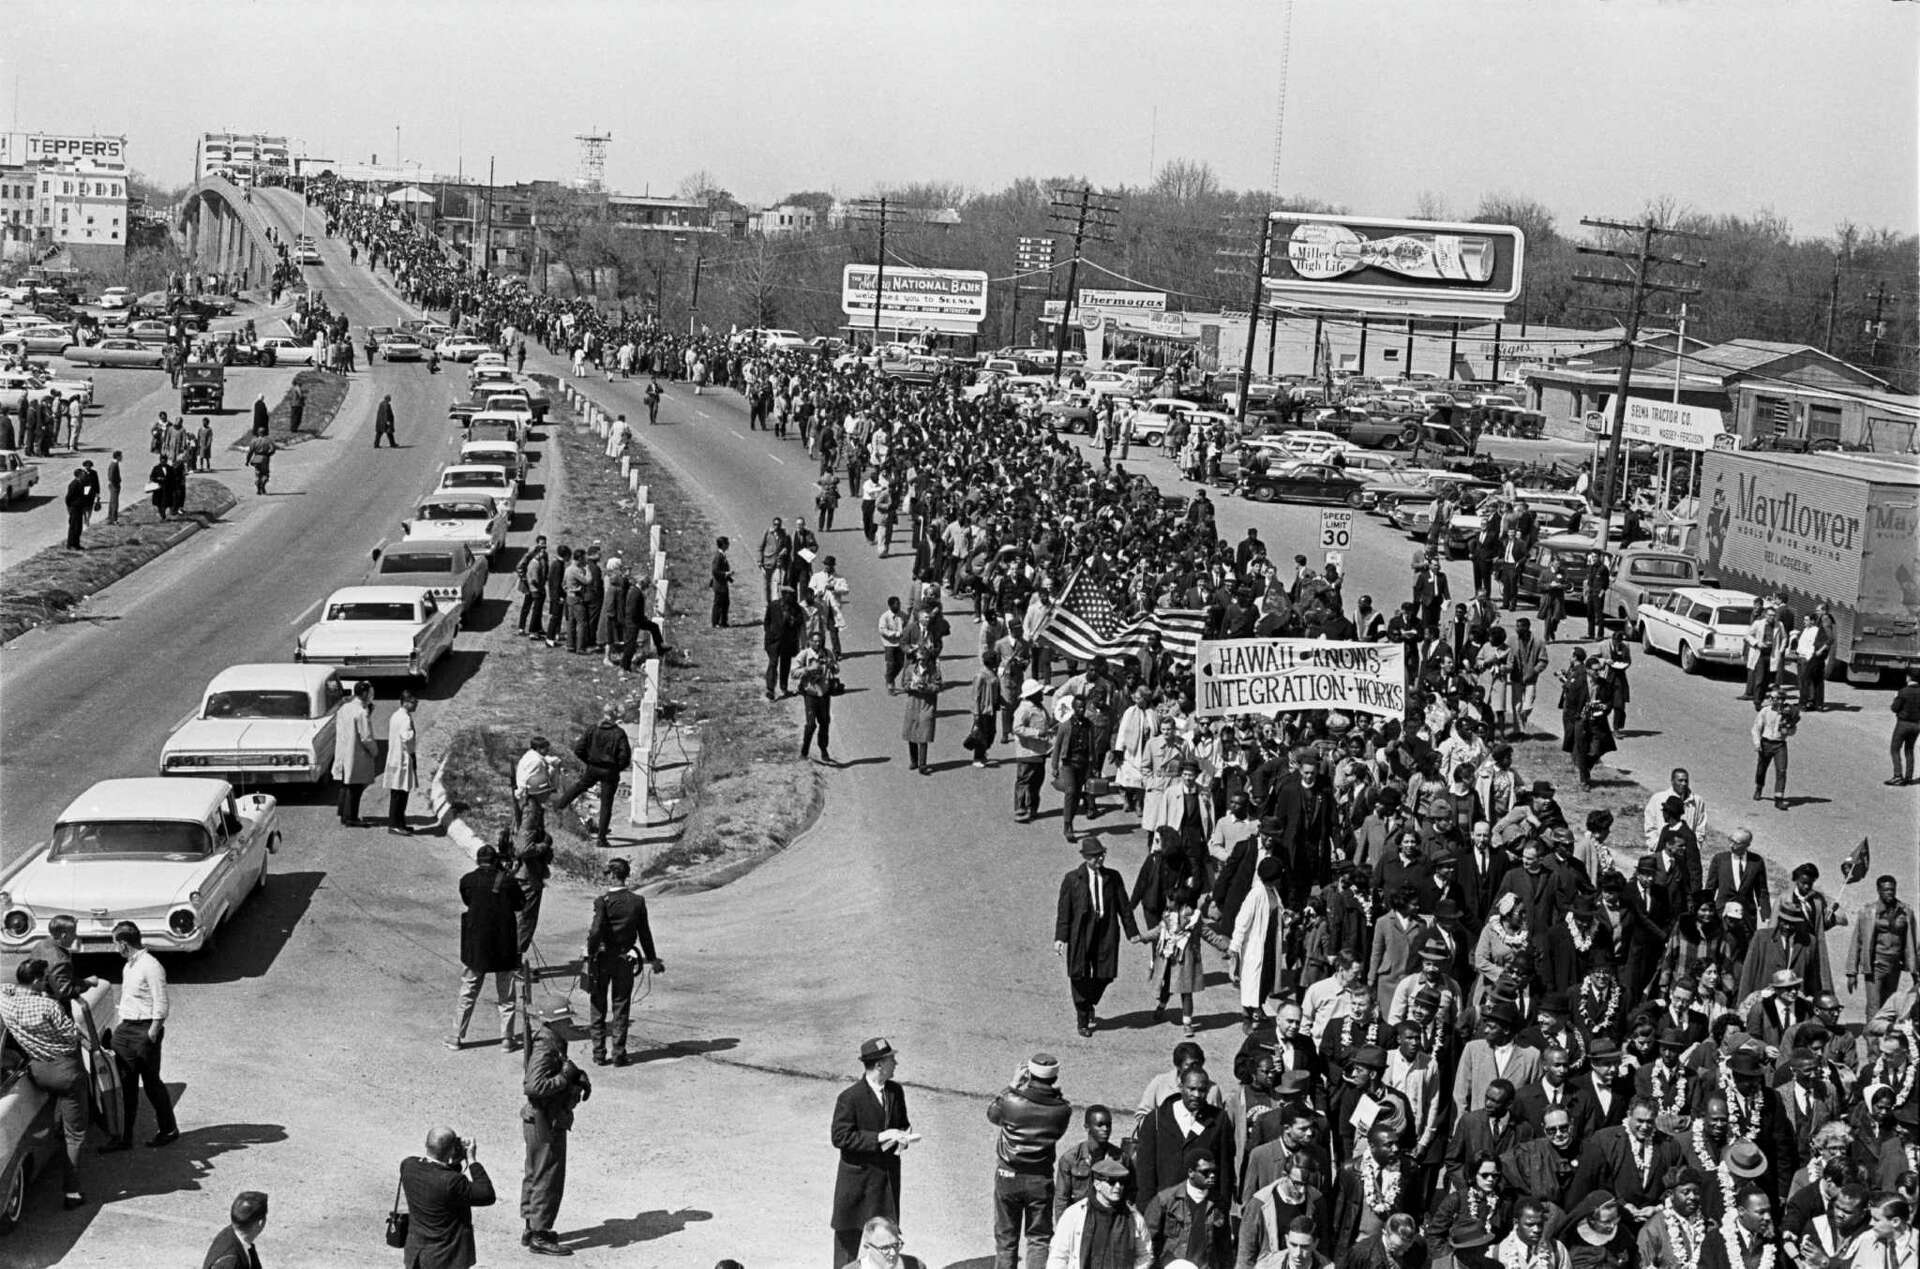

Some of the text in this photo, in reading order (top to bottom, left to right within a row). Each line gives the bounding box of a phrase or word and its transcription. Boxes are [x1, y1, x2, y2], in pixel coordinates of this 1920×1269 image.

[1293, 246, 1329, 259] Miller
[1325, 260, 1347, 272] Life
[893, 277, 949, 291] NATIONAL
[951, 280, 981, 294] BANK
[904, 294, 921, 304] you
[924, 295, 934, 303] to
[939, 295, 974, 305] SELMA
[1082, 294, 1164, 308] Thermogas
[1631, 404, 1649, 419] SELMA
[1652, 407, 1679, 424] TRACTOR
[1323, 512, 1351, 521] SPEED
[1735, 472, 1859, 550] Mayflower
[1325, 521, 1347, 529] LIMIT
[1323, 530, 1349, 546] 30
[1217, 645, 1382, 675] HAWAII KNOWS
